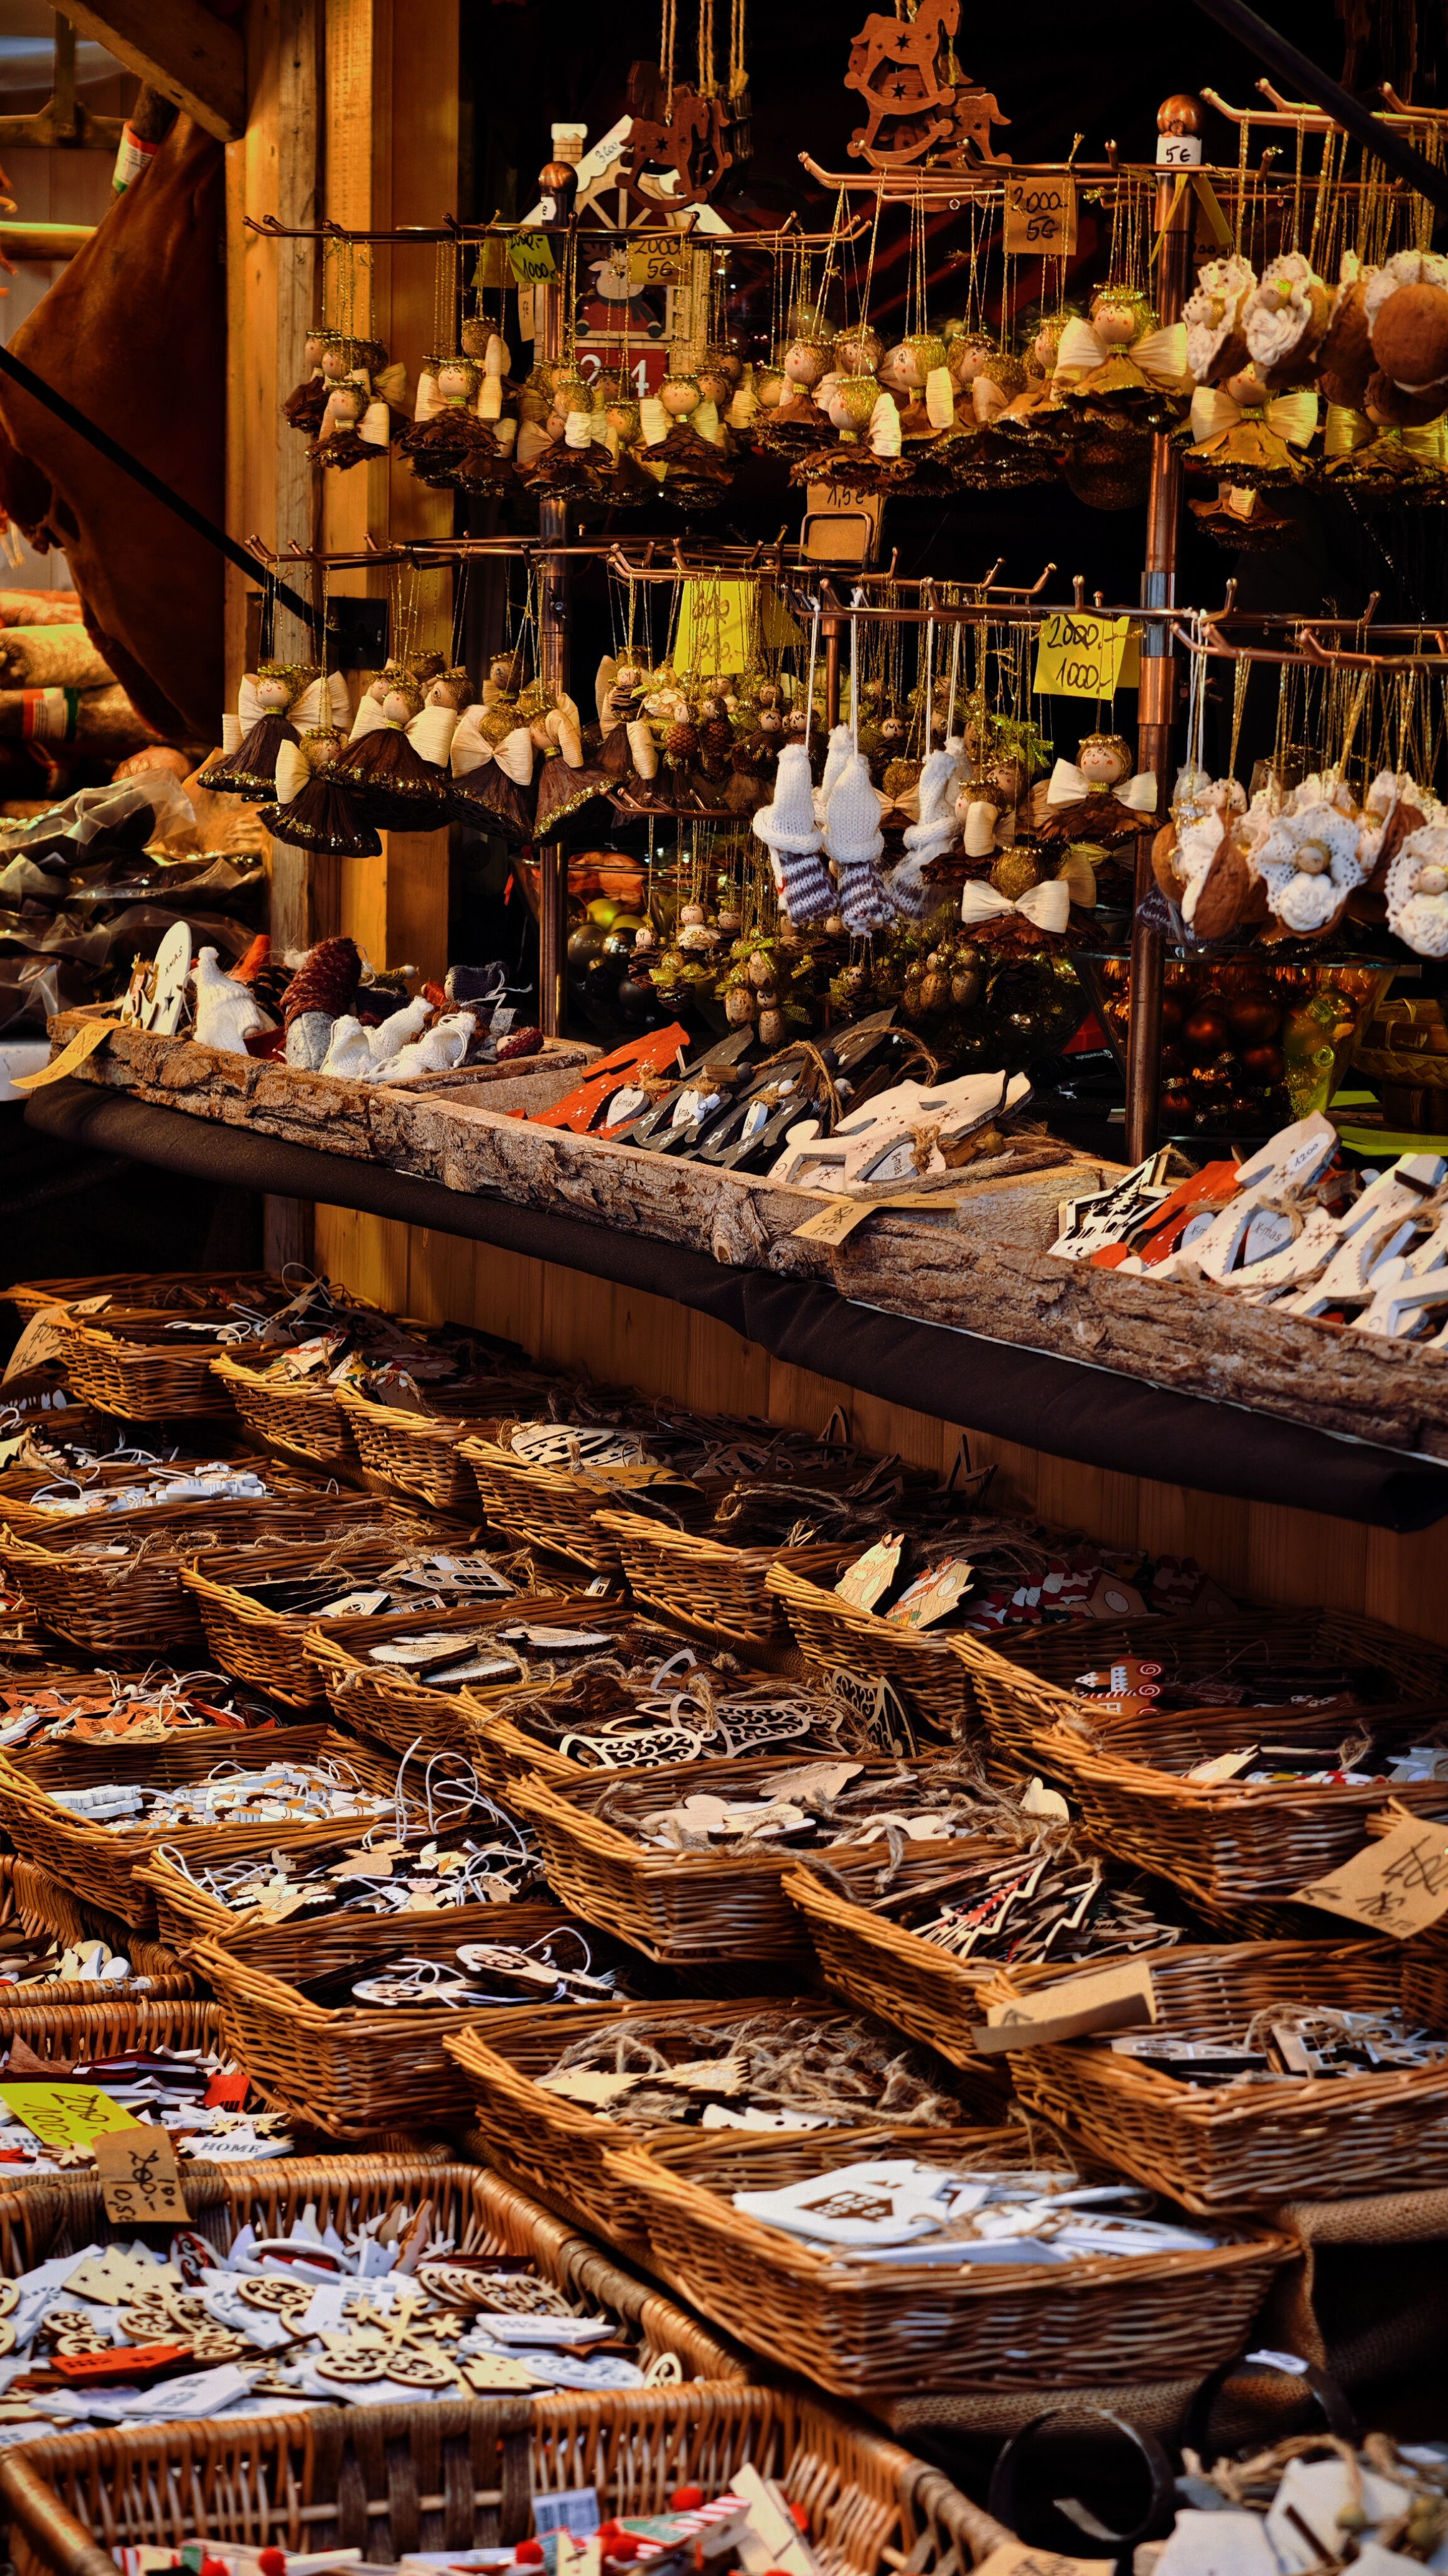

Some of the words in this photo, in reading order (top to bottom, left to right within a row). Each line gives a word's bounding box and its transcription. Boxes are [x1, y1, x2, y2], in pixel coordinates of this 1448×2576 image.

[165, 945, 182, 977] XMAS
[891, 1152, 902, 1175] X-mas
[1252, 1222, 1283, 1243] X-mas
[86, 1720, 106, 1735] HOM
[201, 2141, 262, 2153] HOME
